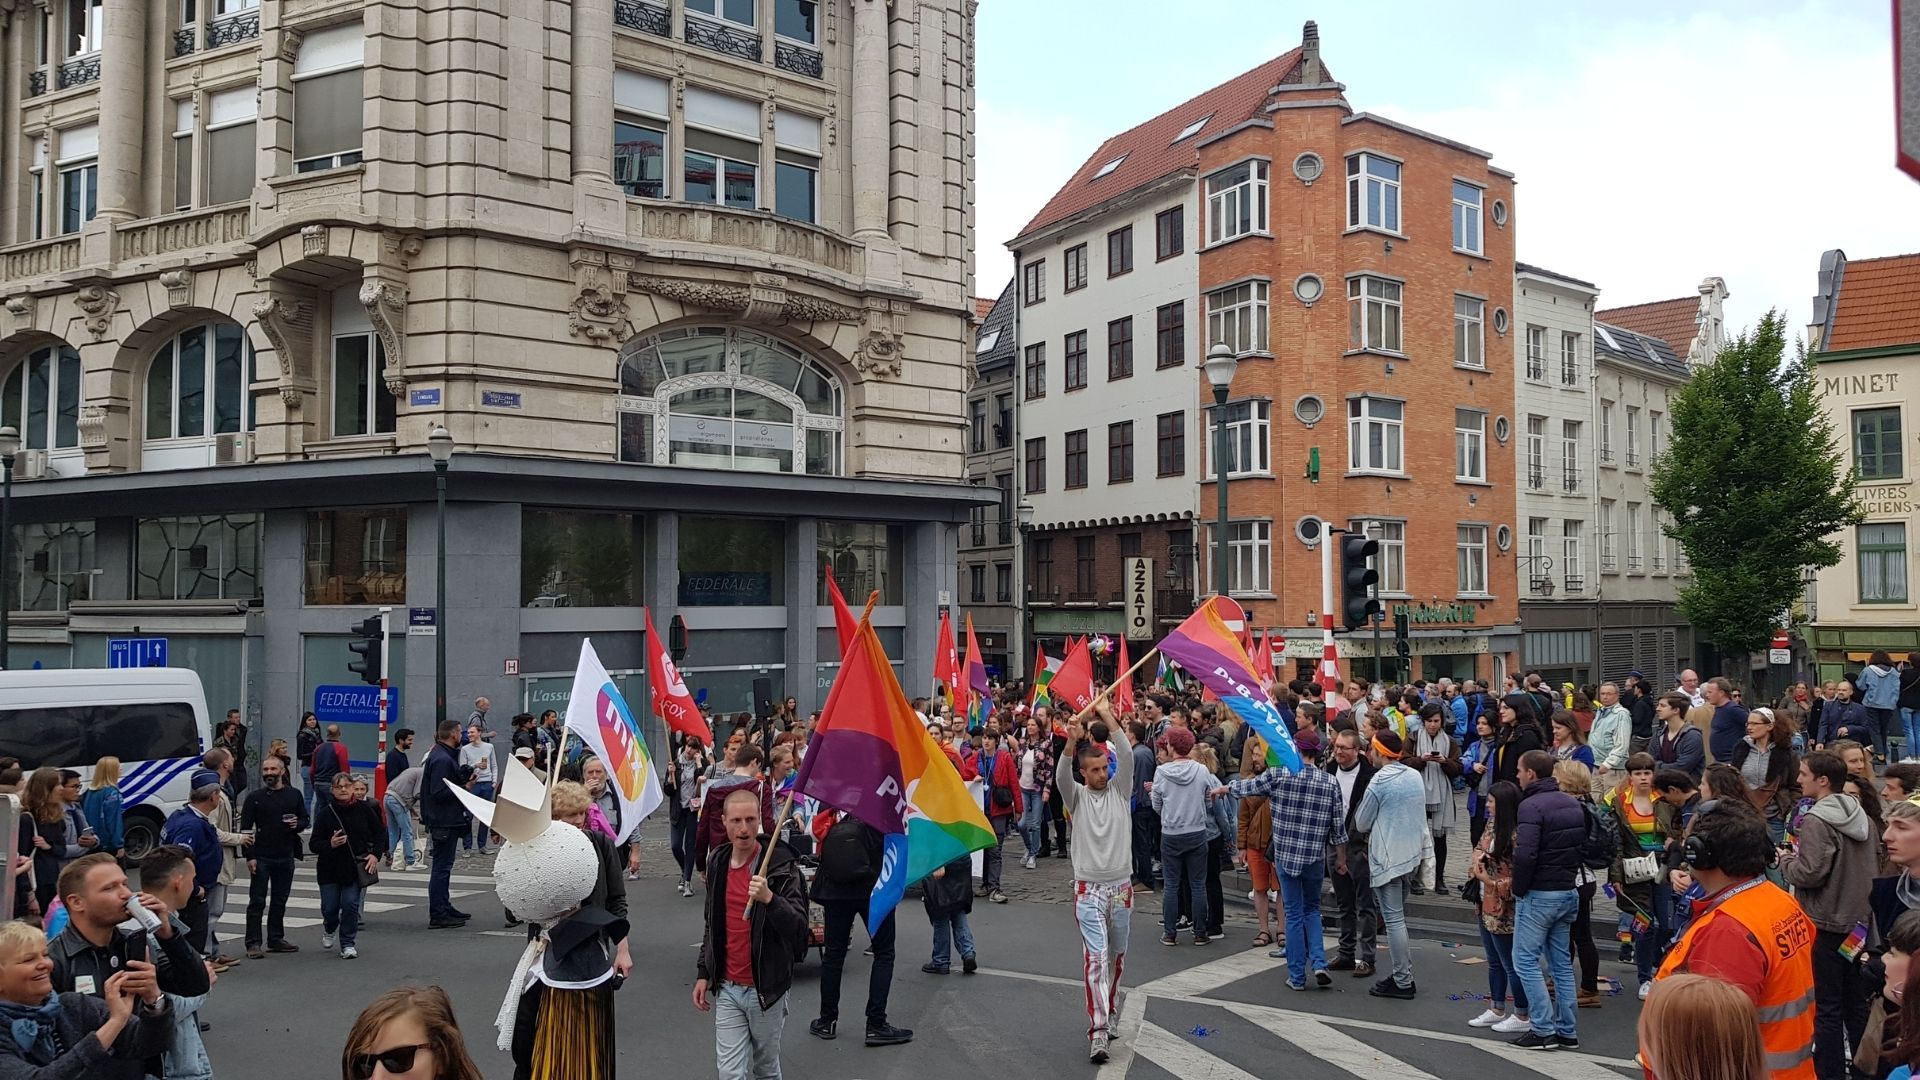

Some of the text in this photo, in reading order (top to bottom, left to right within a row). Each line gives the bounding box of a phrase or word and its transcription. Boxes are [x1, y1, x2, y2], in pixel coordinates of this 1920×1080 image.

[1824, 373, 1899, 396] MINET
[1855, 486, 1907, 500] LIVRES
[1857, 501, 1912, 515] NCIENS
[687, 577, 756, 590] FEDERALE
[1134, 559, 1146, 628] AZZATO
[112, 643, 128, 651] BUS
[506, 660, 518, 673] H
[319, 692, 381, 708] FEDERALE
[532, 689, 571, 702] L'assu
[1775, 918, 1807, 957] STAFF
